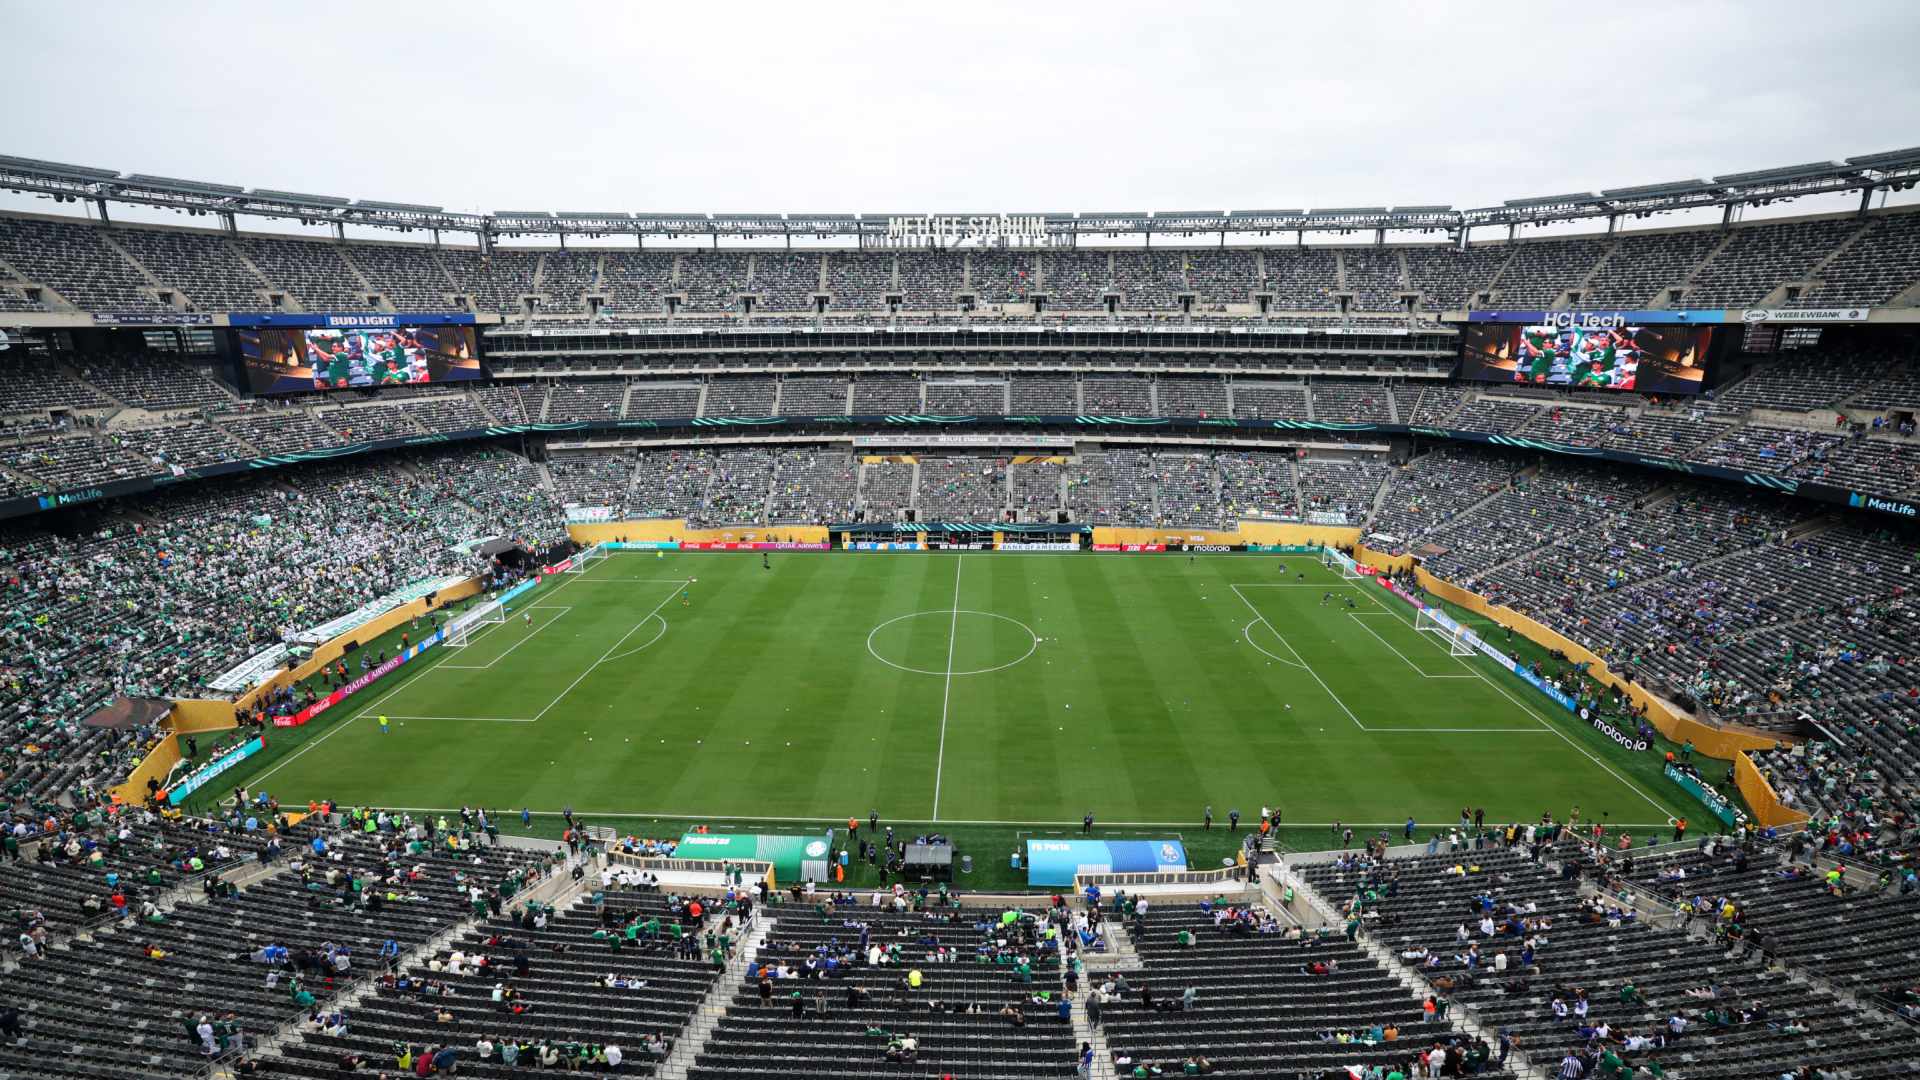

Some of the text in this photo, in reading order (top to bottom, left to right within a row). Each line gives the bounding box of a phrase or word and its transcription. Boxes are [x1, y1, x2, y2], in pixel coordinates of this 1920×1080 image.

[888, 216, 1046, 238] METLIFE STADIUM
[330, 316, 395, 326] BUD LIGHT
[58, 488, 103, 505] MetLife
[1868, 497, 1917, 517] MetLife
[1193, 544, 1231, 552] motorola
[422, 633, 438, 649] VISA
[344, 656, 400, 694] QATAR AIRWAYS
[1544, 685, 1568, 706] ULTRA
[1593, 718, 1647, 751] motorola
[185, 751, 247, 795] Hisense
[1670, 768, 1684, 783] PIF
[1710, 800, 1724, 816] PIF
[684, 836, 731, 846] Palmeiras
